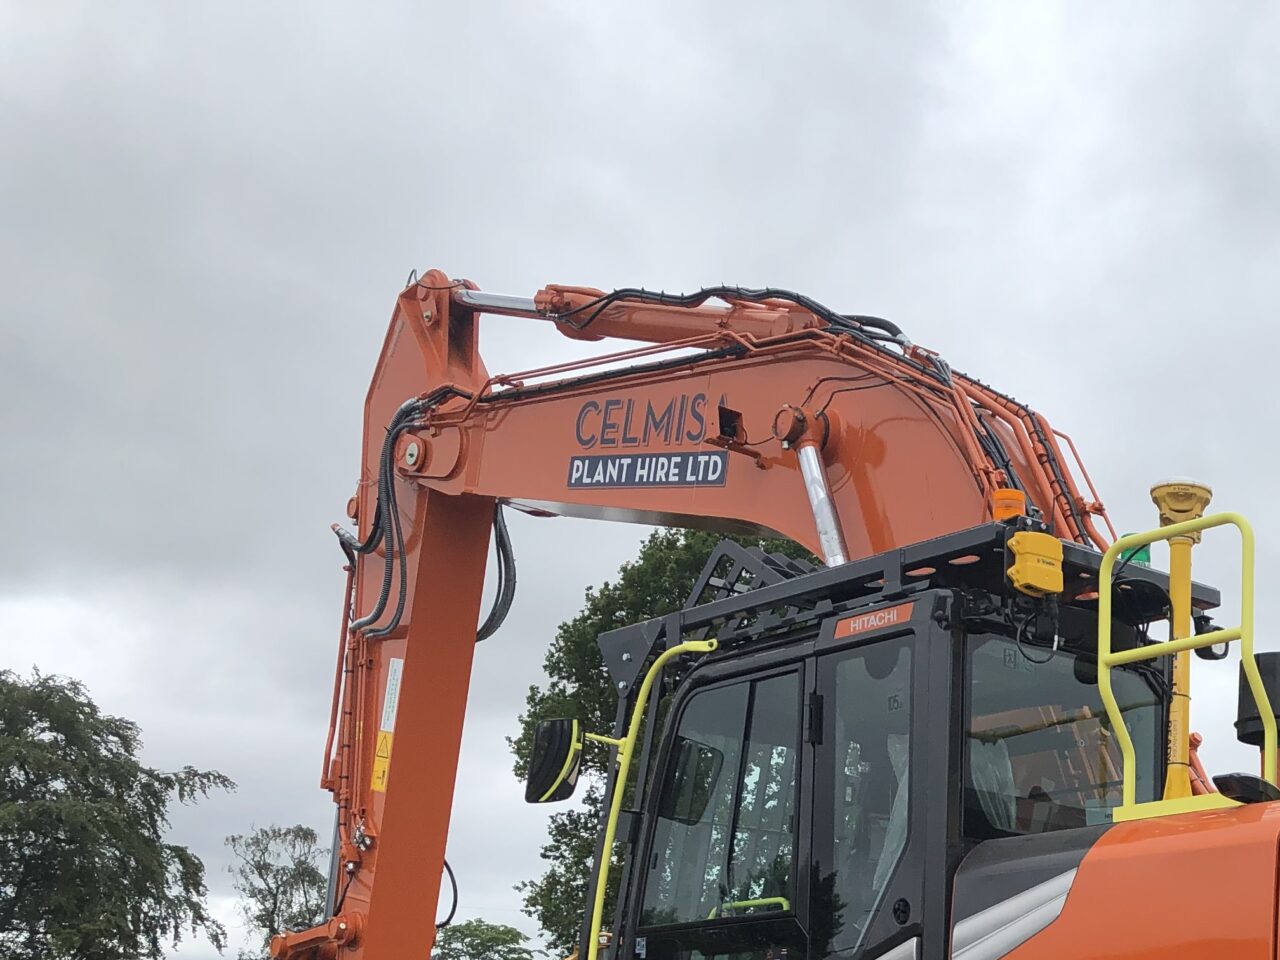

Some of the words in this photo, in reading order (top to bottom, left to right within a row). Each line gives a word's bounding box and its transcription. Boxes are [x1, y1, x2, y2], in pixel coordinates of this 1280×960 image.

[571, 457, 632, 484] PLANT
[635, 456, 681, 482] HIRE
[686, 455, 722, 482] LTD
[850, 609, 897, 632] HITACHI
